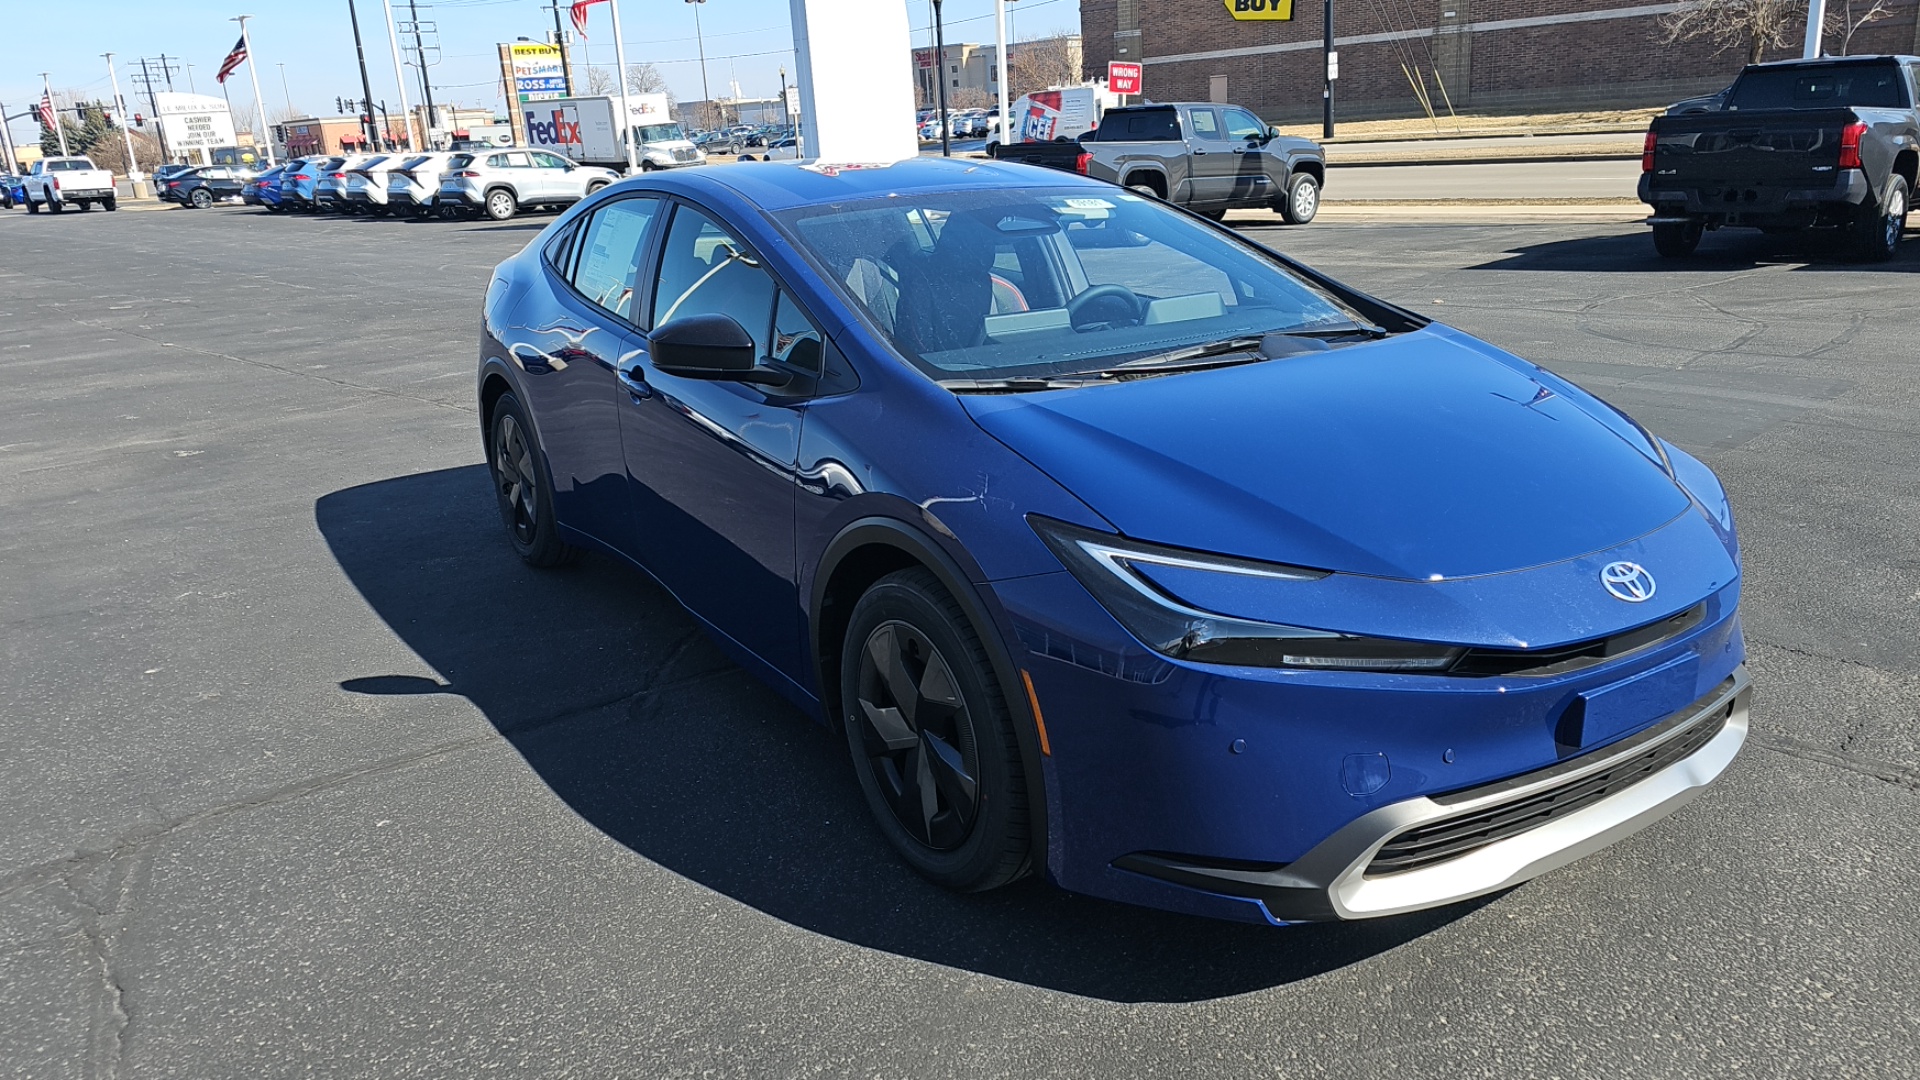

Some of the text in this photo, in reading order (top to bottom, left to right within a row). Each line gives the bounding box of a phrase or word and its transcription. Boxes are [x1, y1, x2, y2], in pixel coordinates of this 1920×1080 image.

[1235, 0, 1281, 12] BUY
[539, 47, 558, 55] BUY
[1112, 67, 1138, 78] WRONG
[517, 80, 545, 90] ROSS
[1117, 79, 1133, 90] WAY
[628, 103, 656, 116] edEx
[184, 116, 212, 124] CASHIER
[525, 109, 582, 145] FedEx
[177, 137, 225, 147] WINNING TEAM
